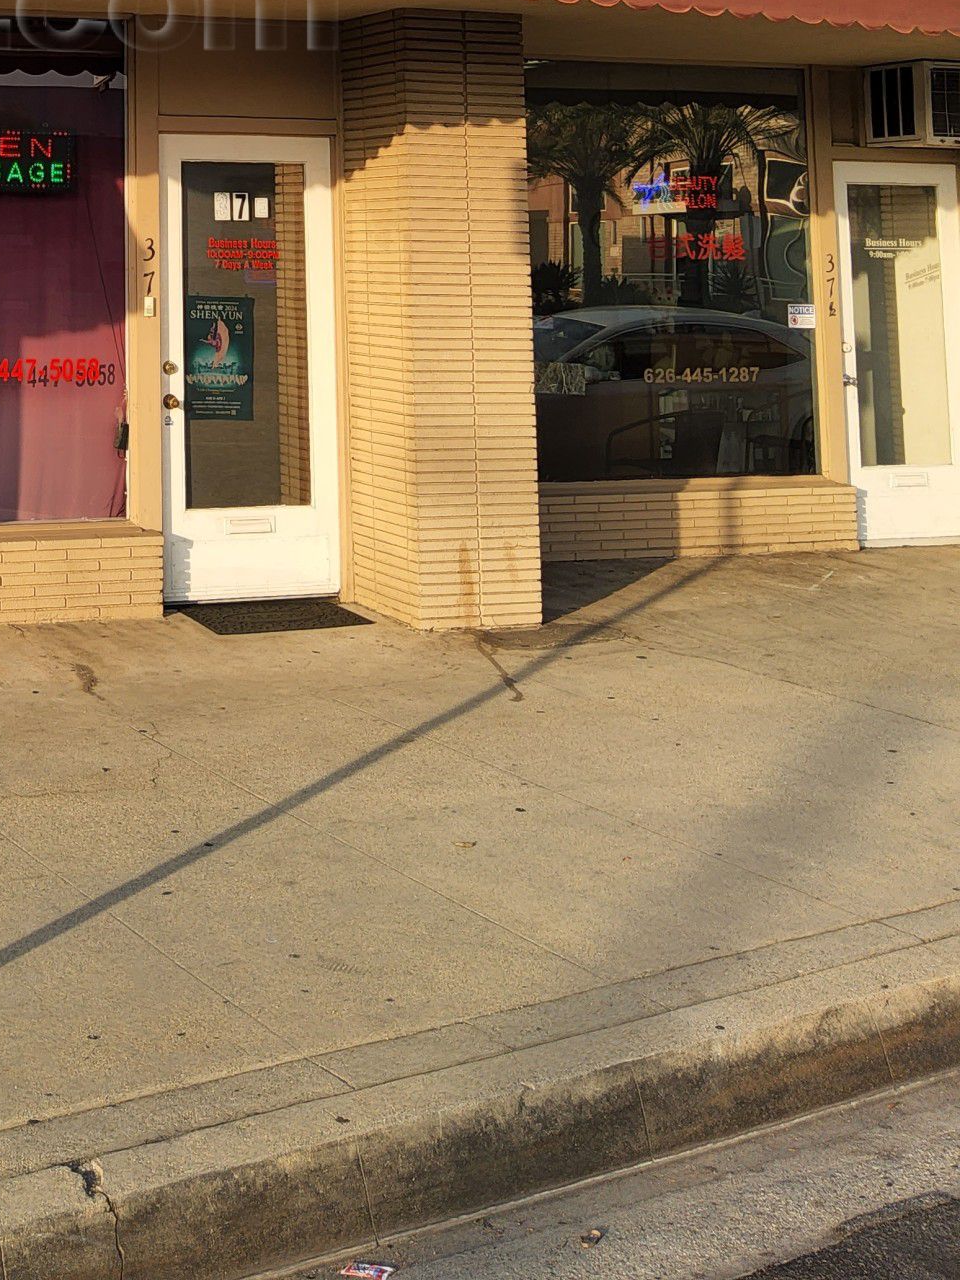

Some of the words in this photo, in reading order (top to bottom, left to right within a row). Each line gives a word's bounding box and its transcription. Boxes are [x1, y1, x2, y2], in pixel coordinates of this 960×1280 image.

[668, 176, 718, 191] BEAUTY
[208, 236, 248, 248] Business
[864, 237, 897, 247] Business
[898, 238, 922, 248] Hours
[223, 260, 242, 271] Days
[244, 260, 250, 269] A
[251, 260, 274, 270] Week
[190, 310, 219, 320] SHEN
[221, 311, 244, 320] YUN
[789, 306, 814, 314] NOTICE
[643, 366, 760, 383] 626-445-1287
